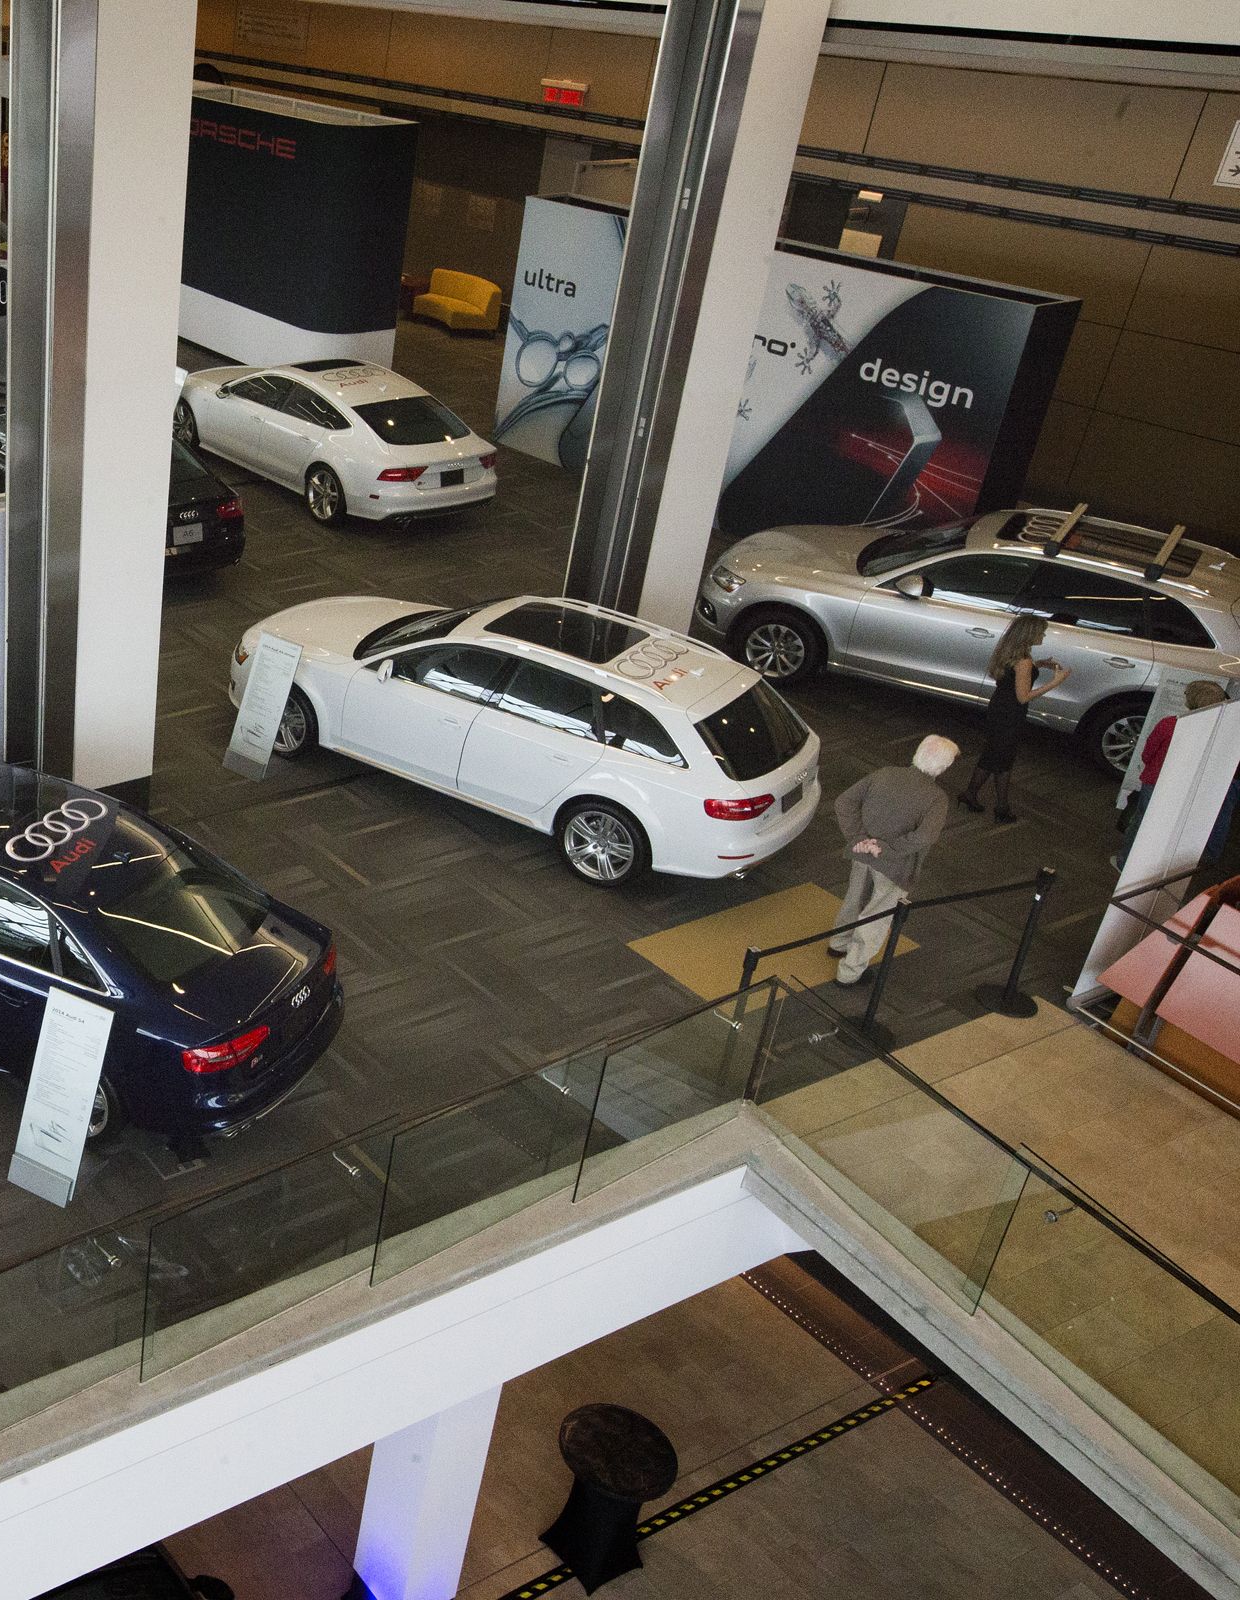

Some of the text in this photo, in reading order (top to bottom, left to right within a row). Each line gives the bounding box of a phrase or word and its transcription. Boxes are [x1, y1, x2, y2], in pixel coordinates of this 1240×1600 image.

[190, 117, 297, 160] ORSCHE
[524, 268, 576, 298] ultra
[340, 379, 369, 388] Audi
[859, 358, 975, 410] design
[50, 836, 97, 874] Audi
